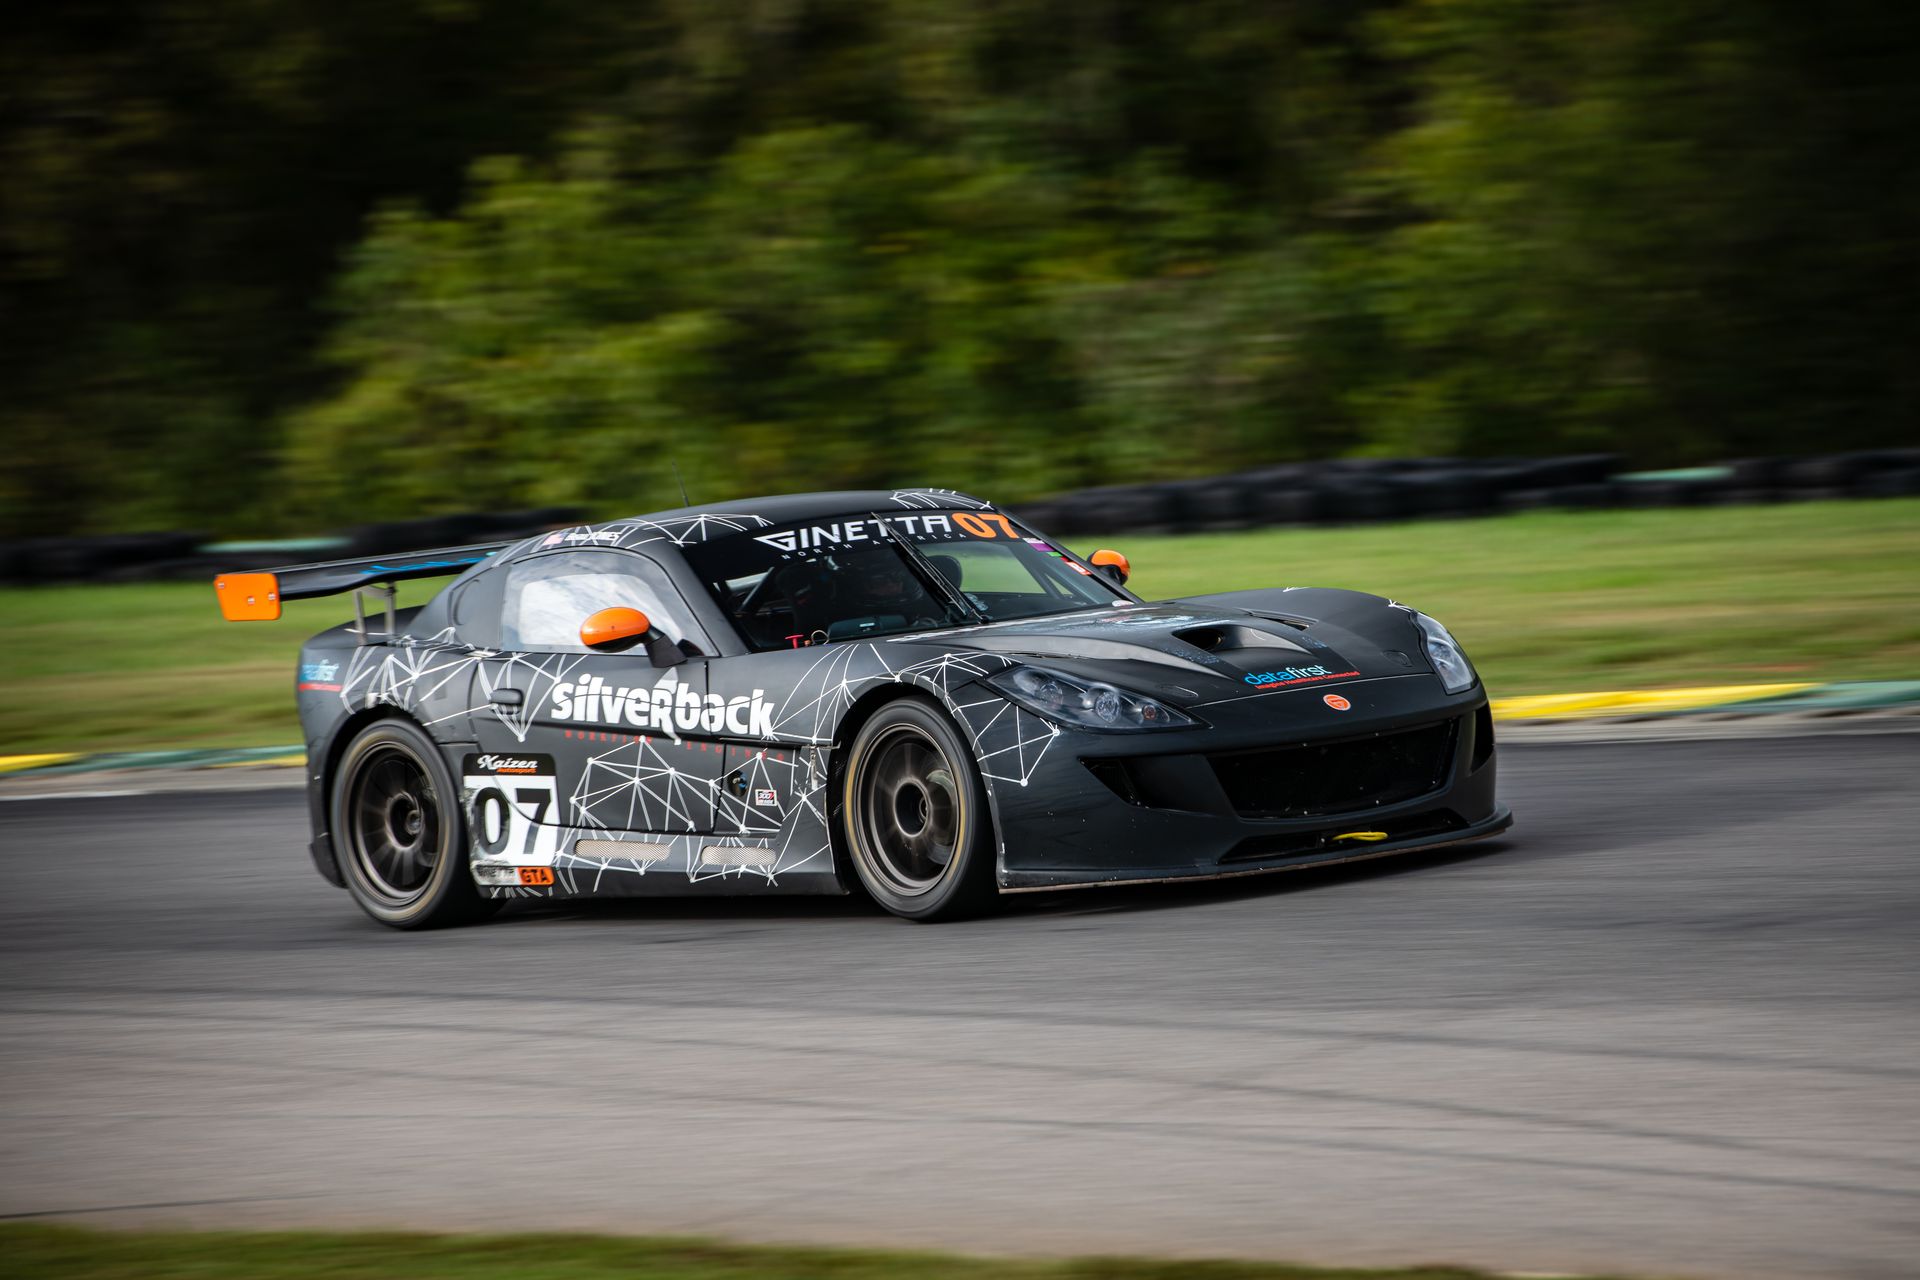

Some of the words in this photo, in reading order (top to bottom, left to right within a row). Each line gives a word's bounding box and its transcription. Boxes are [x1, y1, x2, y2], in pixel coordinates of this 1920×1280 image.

[753, 515, 953, 551] GINETTA
[951, 512, 1020, 539] 07
[781, 543, 853, 560] NORTH
[872, 532, 967, 545] AMRICA
[1244, 664, 1332, 685] datafirst
[477, 754, 538, 770] Kaizen
[473, 786, 552, 855] 07
[521, 868, 551, 884] GTA
